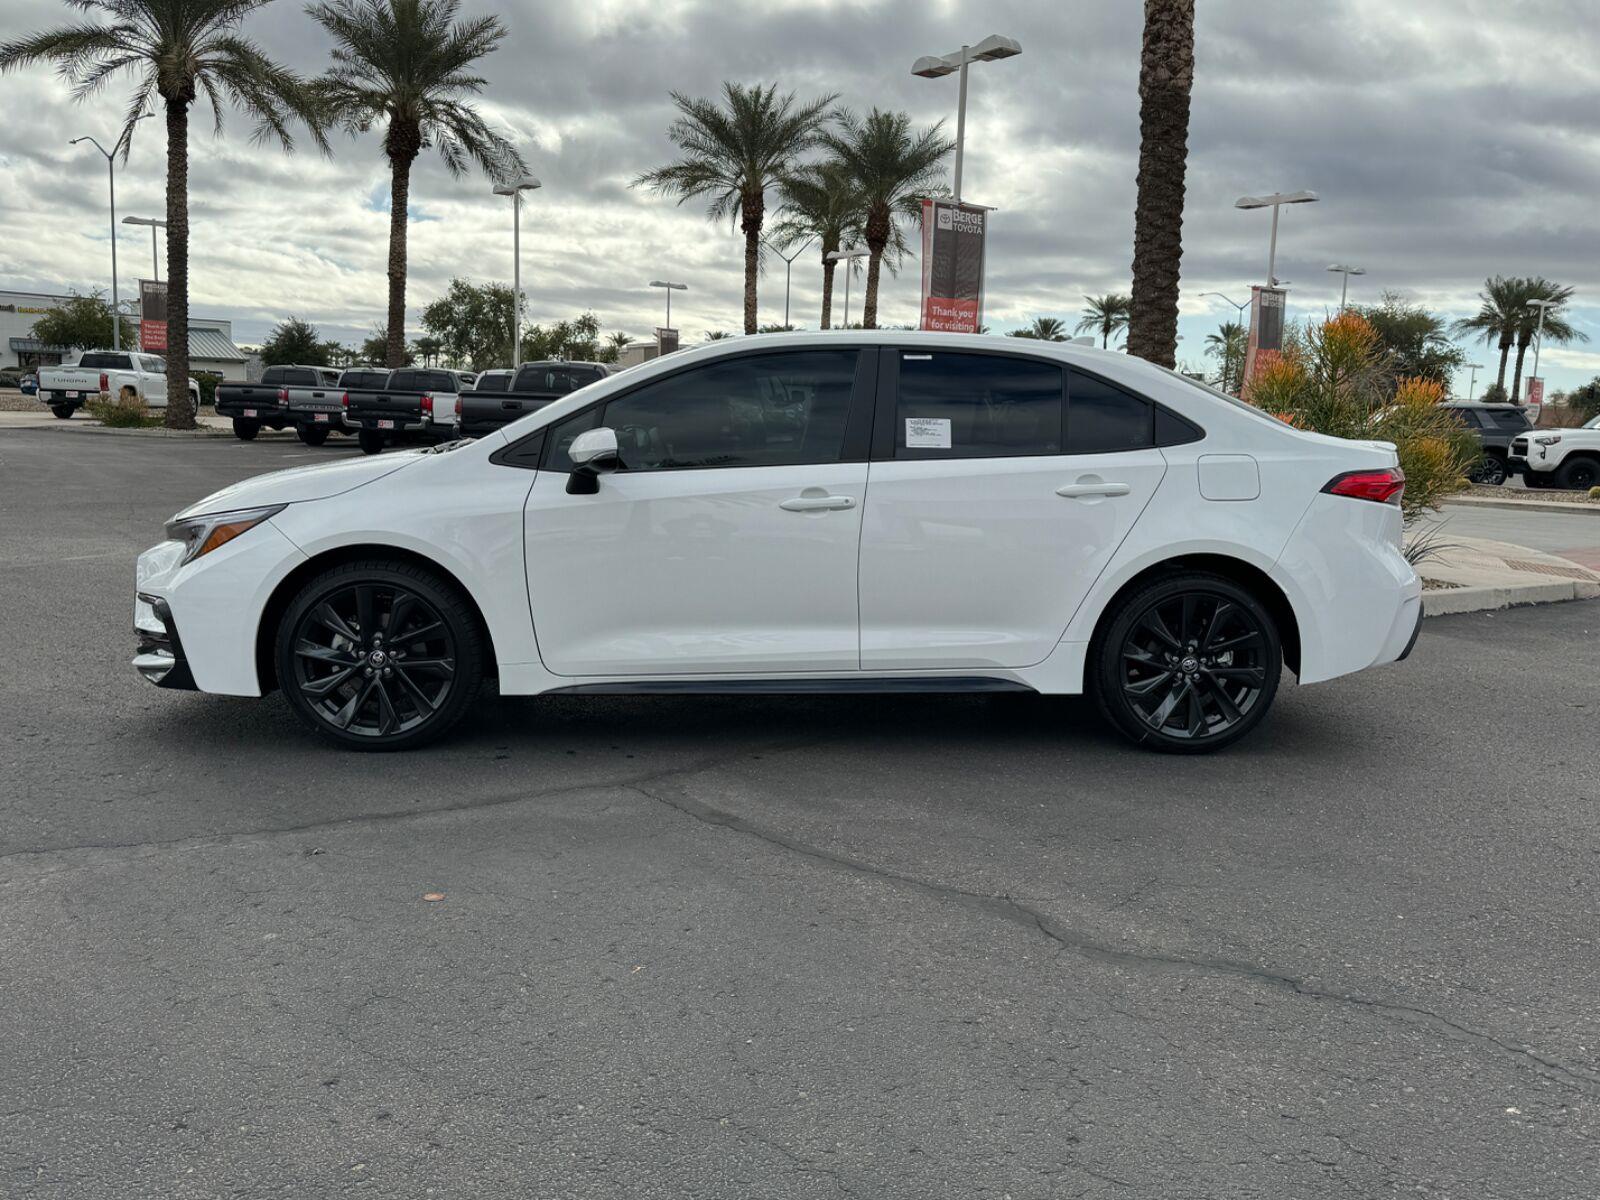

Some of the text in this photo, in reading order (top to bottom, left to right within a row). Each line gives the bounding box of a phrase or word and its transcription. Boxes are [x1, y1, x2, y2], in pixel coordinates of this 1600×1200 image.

[953, 208, 983, 225] BERGE
[953, 223, 983, 234] TOYOTA
[932, 305, 974, 320] Thank you
[931, 318, 975, 333] for visiting
